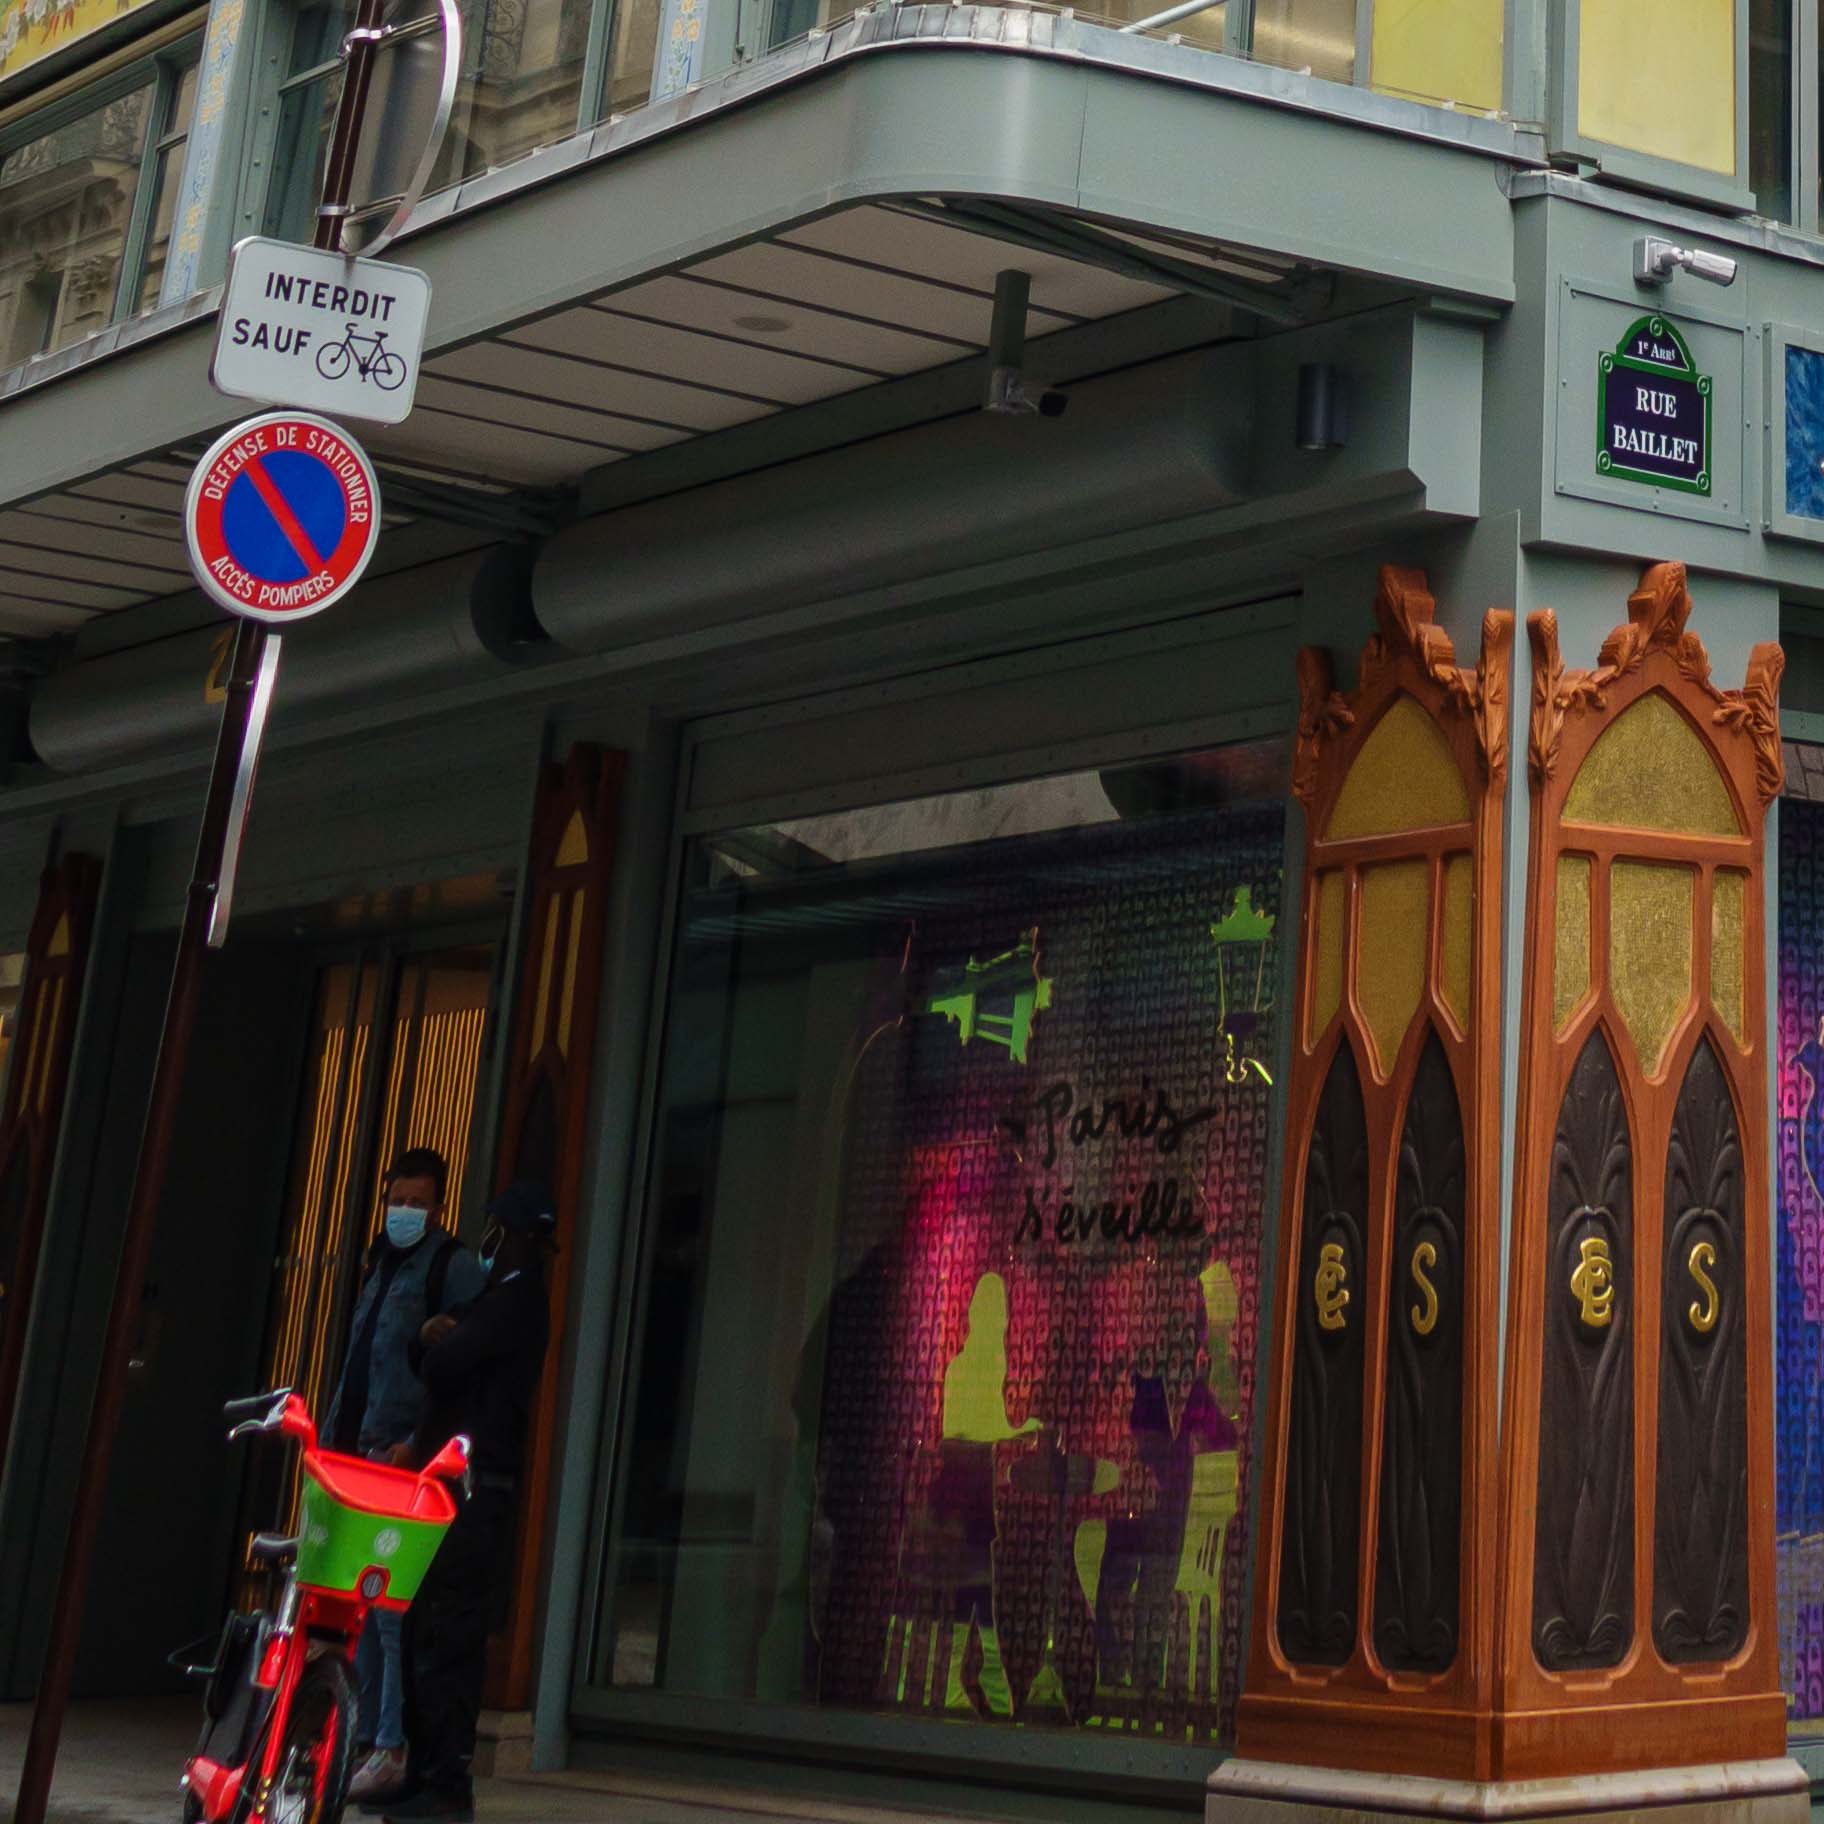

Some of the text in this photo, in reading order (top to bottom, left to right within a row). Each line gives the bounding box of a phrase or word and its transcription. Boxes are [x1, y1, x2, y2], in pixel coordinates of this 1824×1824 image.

[265, 271, 396, 321] INTERDIT
[232, 318, 312, 356] SAUF
[1635, 386, 1678, 419] RUE
[1613, 423, 1699, 464] BAILLET
[204, 426, 369, 524] DÉFENSE DE STATIONNER
[258, 570, 335, 606] POMPIERS
[1000, 1074, 1218, 1169] Paris
